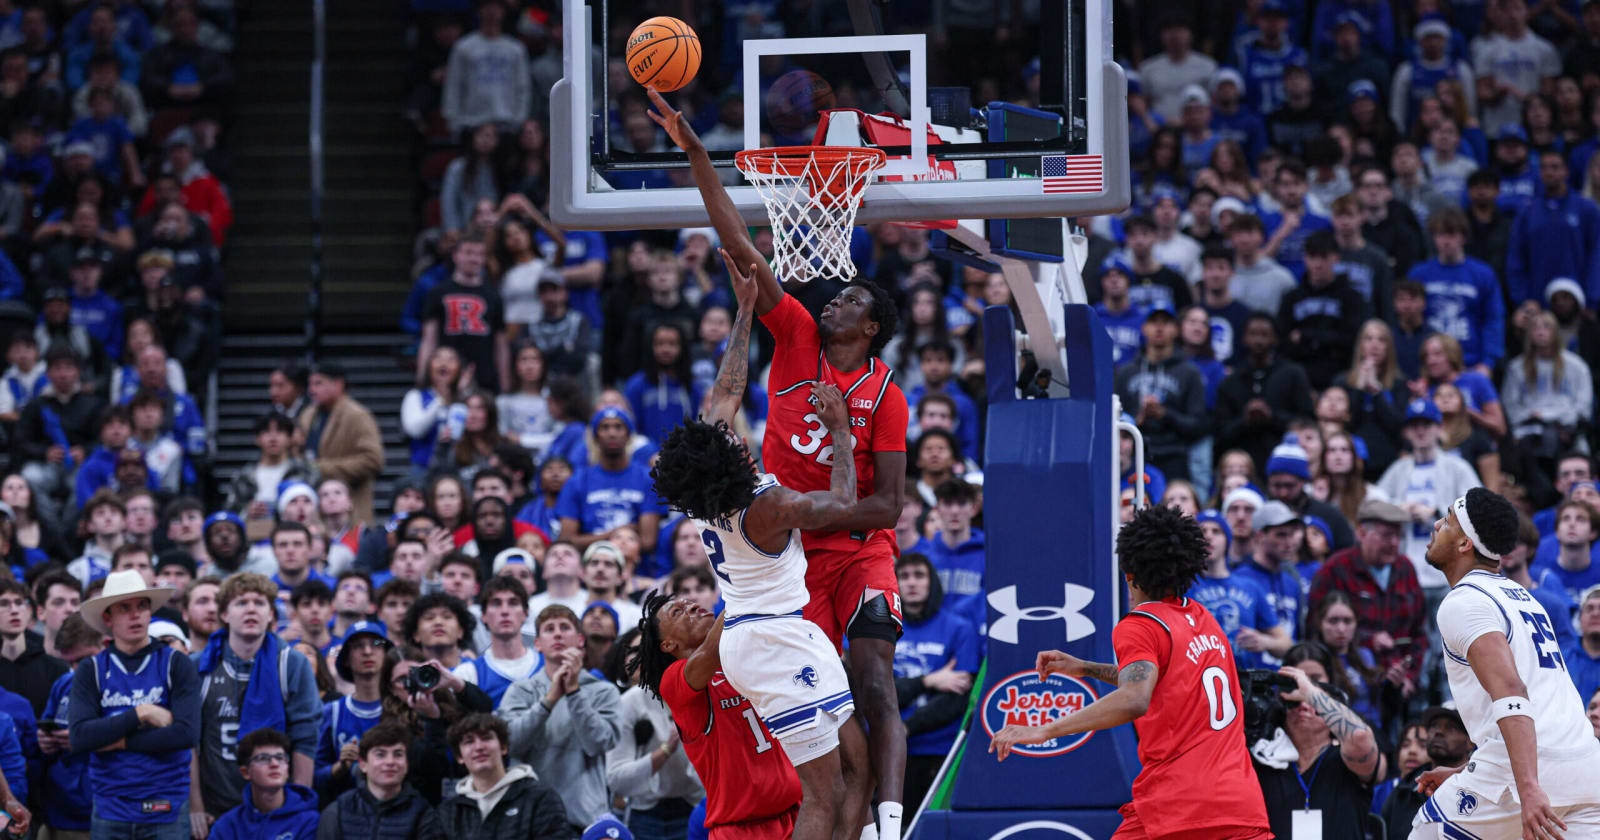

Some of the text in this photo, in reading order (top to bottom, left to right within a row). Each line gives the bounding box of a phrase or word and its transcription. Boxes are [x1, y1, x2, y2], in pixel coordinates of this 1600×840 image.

[443, 294, 488, 335] R
[702, 528, 733, 585] 2
[998, 686, 1085, 713] Jersey
[1202, 666, 1237, 731] 0
